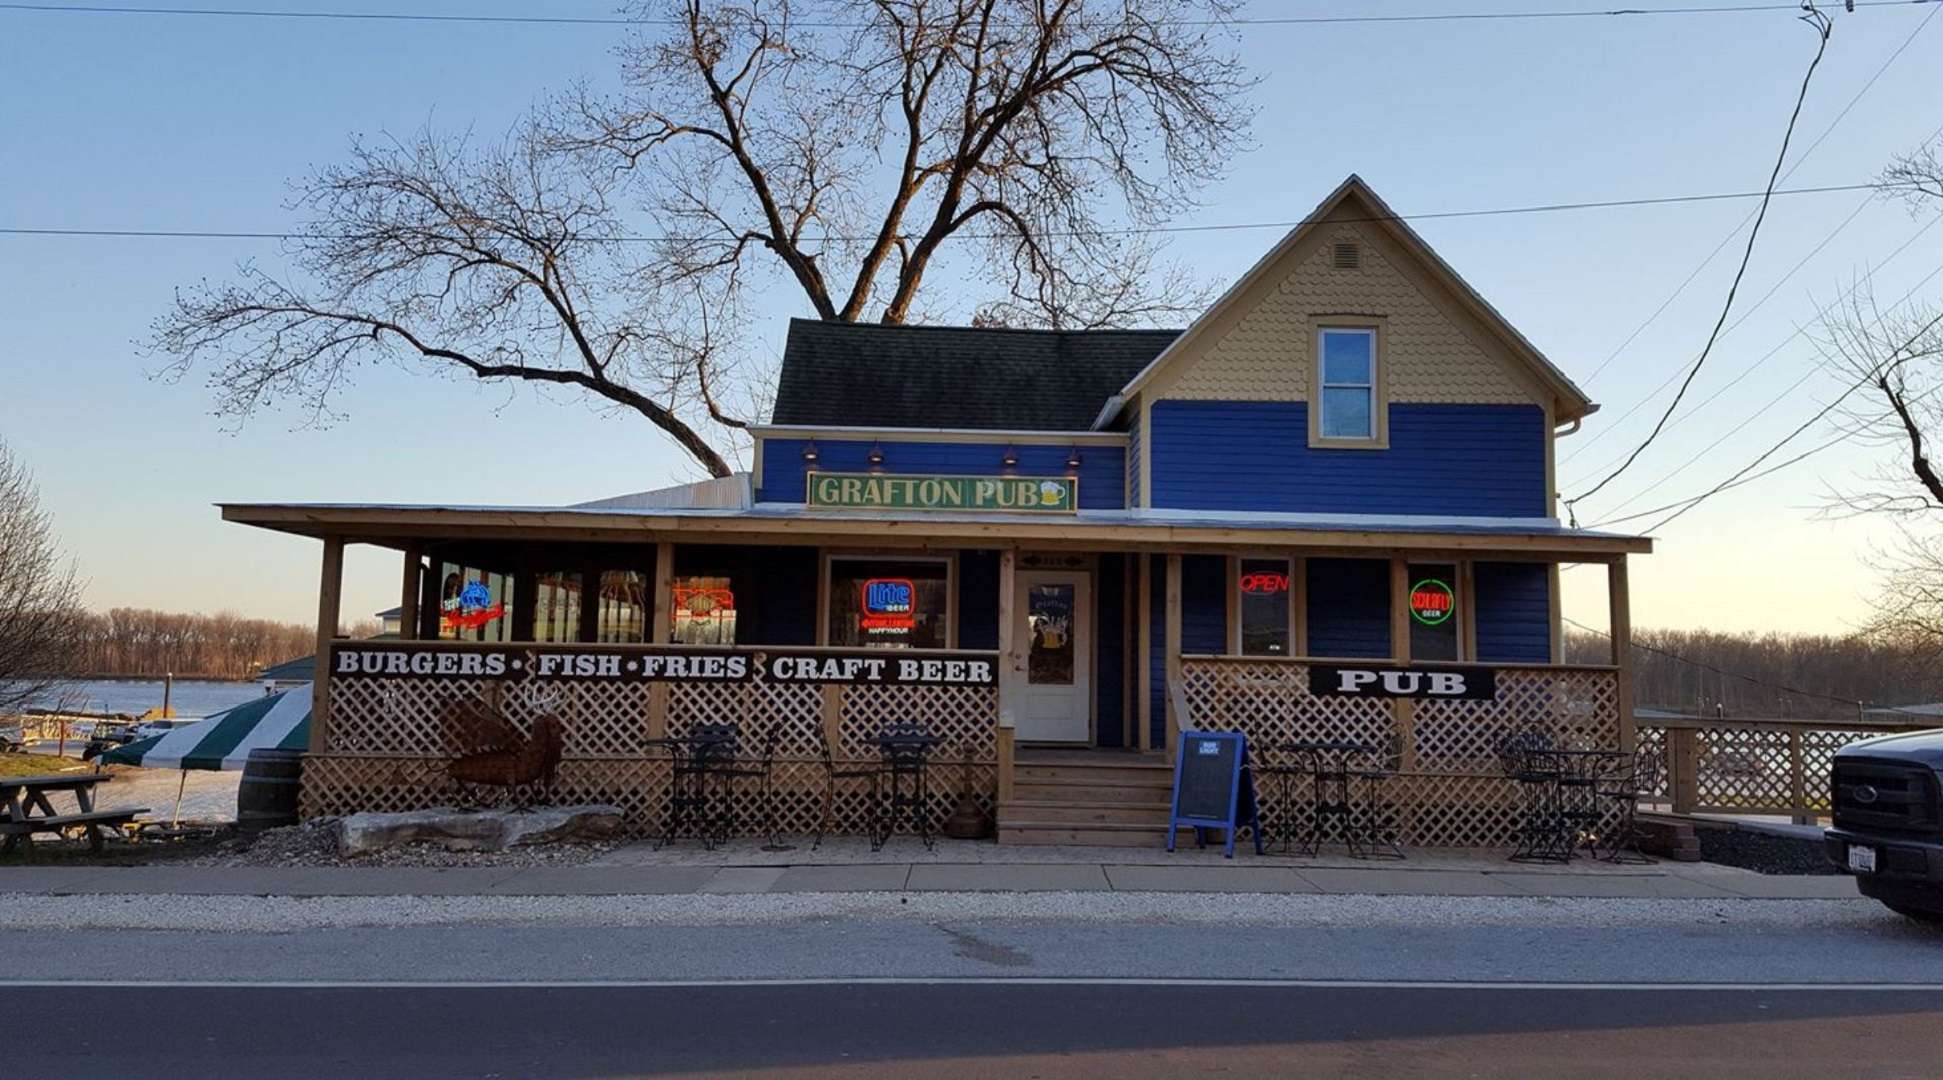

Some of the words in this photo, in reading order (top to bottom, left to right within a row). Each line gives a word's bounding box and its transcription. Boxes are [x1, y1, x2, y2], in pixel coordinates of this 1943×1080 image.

[818, 478, 961, 506] GRAFTON
[975, 481, 1038, 506] PUB
[1239, 575, 1290, 592] OPEN
[337, 651, 506, 674] BURGERS
[538, 655, 621, 676] FISH
[642, 655, 747, 678] FRIES
[772, 657, 885, 680] CRAFT
[898, 659, 992, 682] BEER
[1337, 670, 1467, 695] PUB
